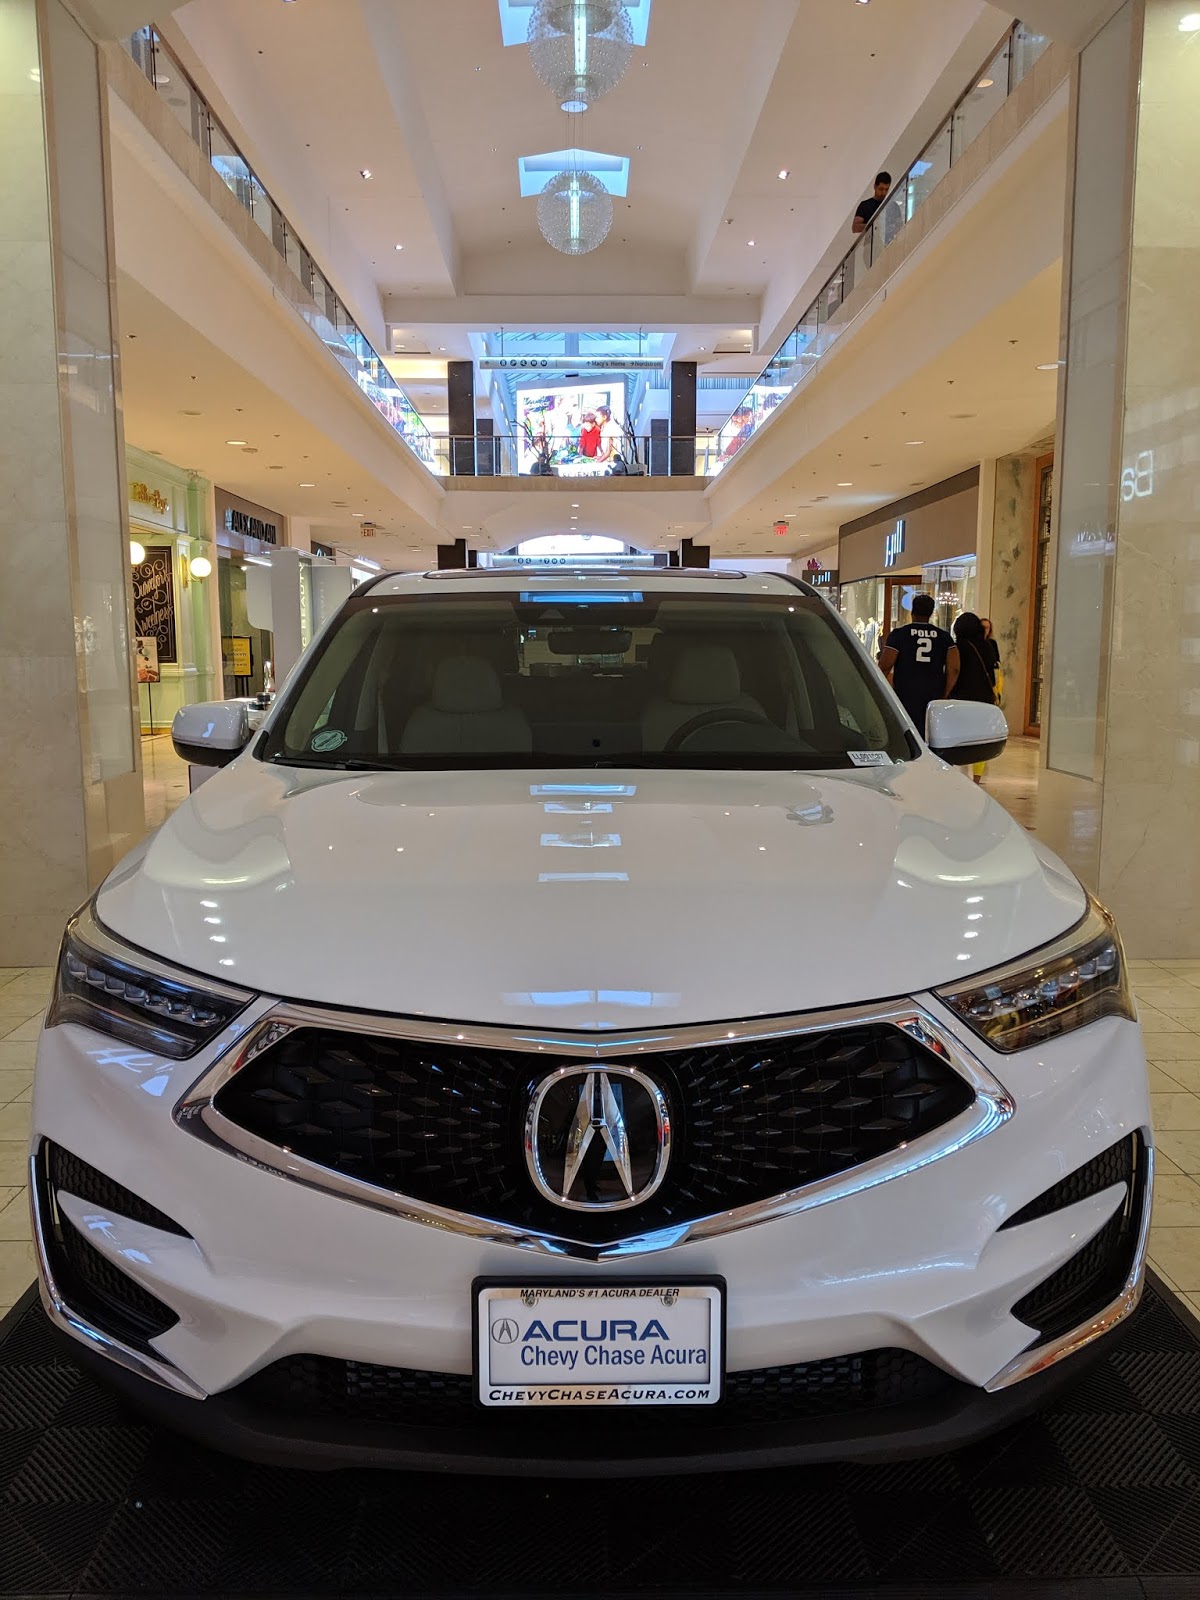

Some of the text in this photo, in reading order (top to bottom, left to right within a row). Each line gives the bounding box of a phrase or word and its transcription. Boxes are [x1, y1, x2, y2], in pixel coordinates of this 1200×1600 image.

[231, 509, 249, 536] ALEX
[910, 628, 938, 638] POLO
[915, 637, 933, 663] 2
[520, 1288, 680, 1298] MARYLAND'S #1 ACURA DEALER
[521, 1319, 670, 1342] ACURA
[521, 1344, 707, 1370] Chevy Chase Acura
